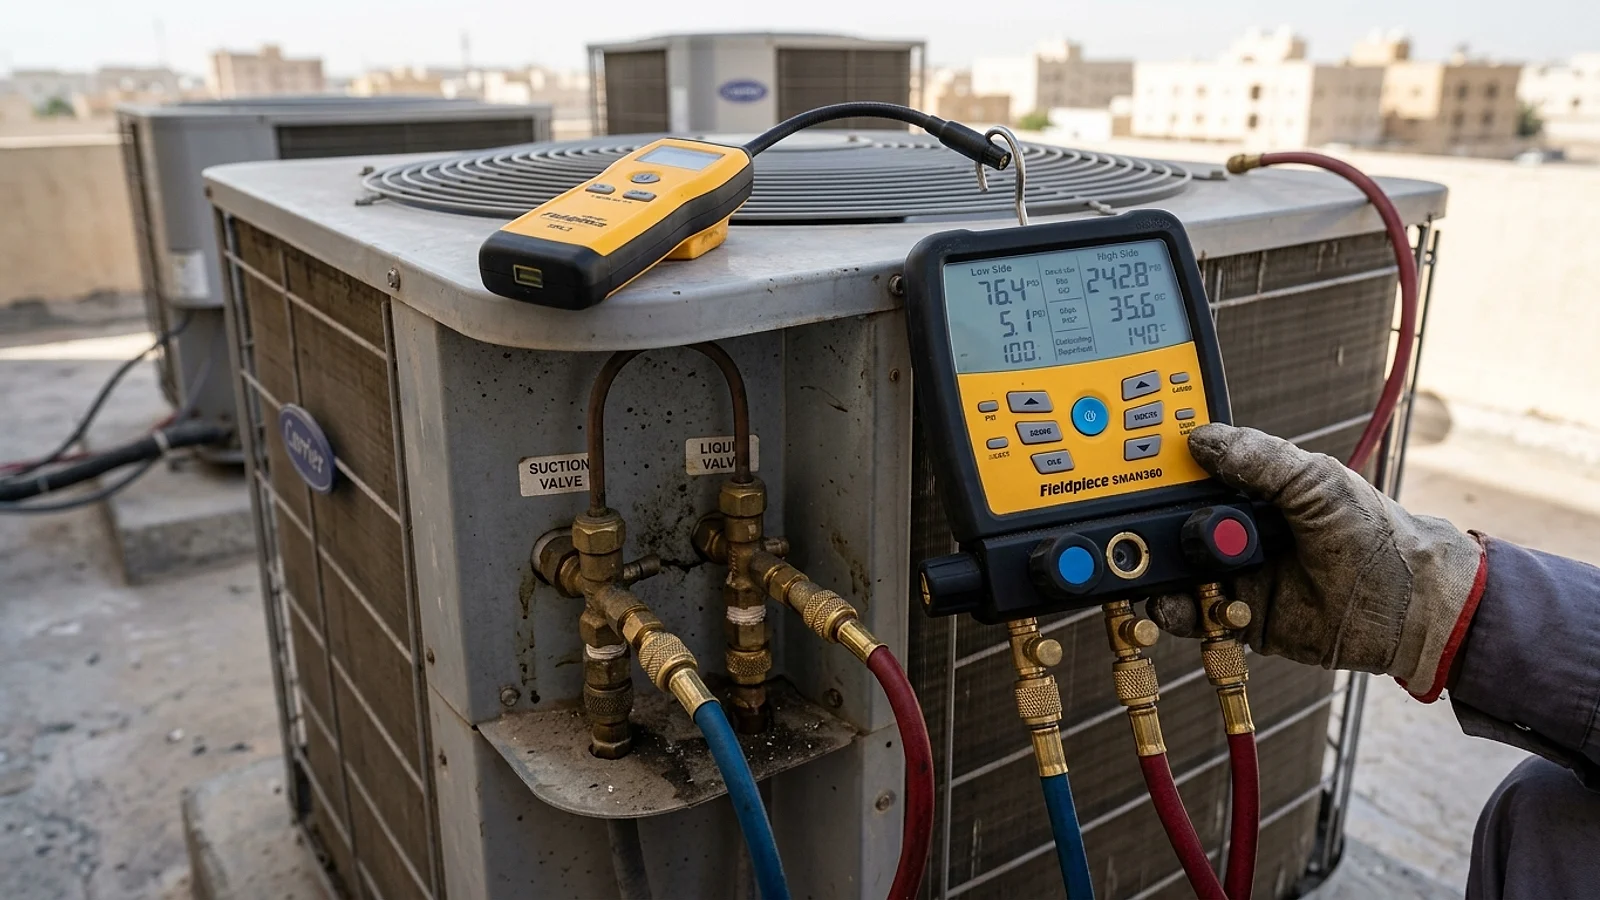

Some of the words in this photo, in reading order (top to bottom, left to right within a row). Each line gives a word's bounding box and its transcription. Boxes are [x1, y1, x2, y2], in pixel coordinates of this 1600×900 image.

[1097, 251, 1118, 262] High
[971, 267, 990, 276] Low
[992, 264, 1012, 274] Side
[1087, 262, 1149, 293] 242.8
[978, 278, 1026, 305] 76.4
[1109, 292, 1156, 322] 35.6
[1000, 309, 1032, 338] 5.1
[1129, 324, 1159, 346] 140
[701, 441, 736, 454] LIQUI
[530, 458, 590, 475] SUCTION
[702, 457, 736, 470] VALV
[539, 475, 583, 490] VALVE
[1040, 476, 1110, 497] Fieldpiece
[1112, 468, 1163, 485] SMAN360
